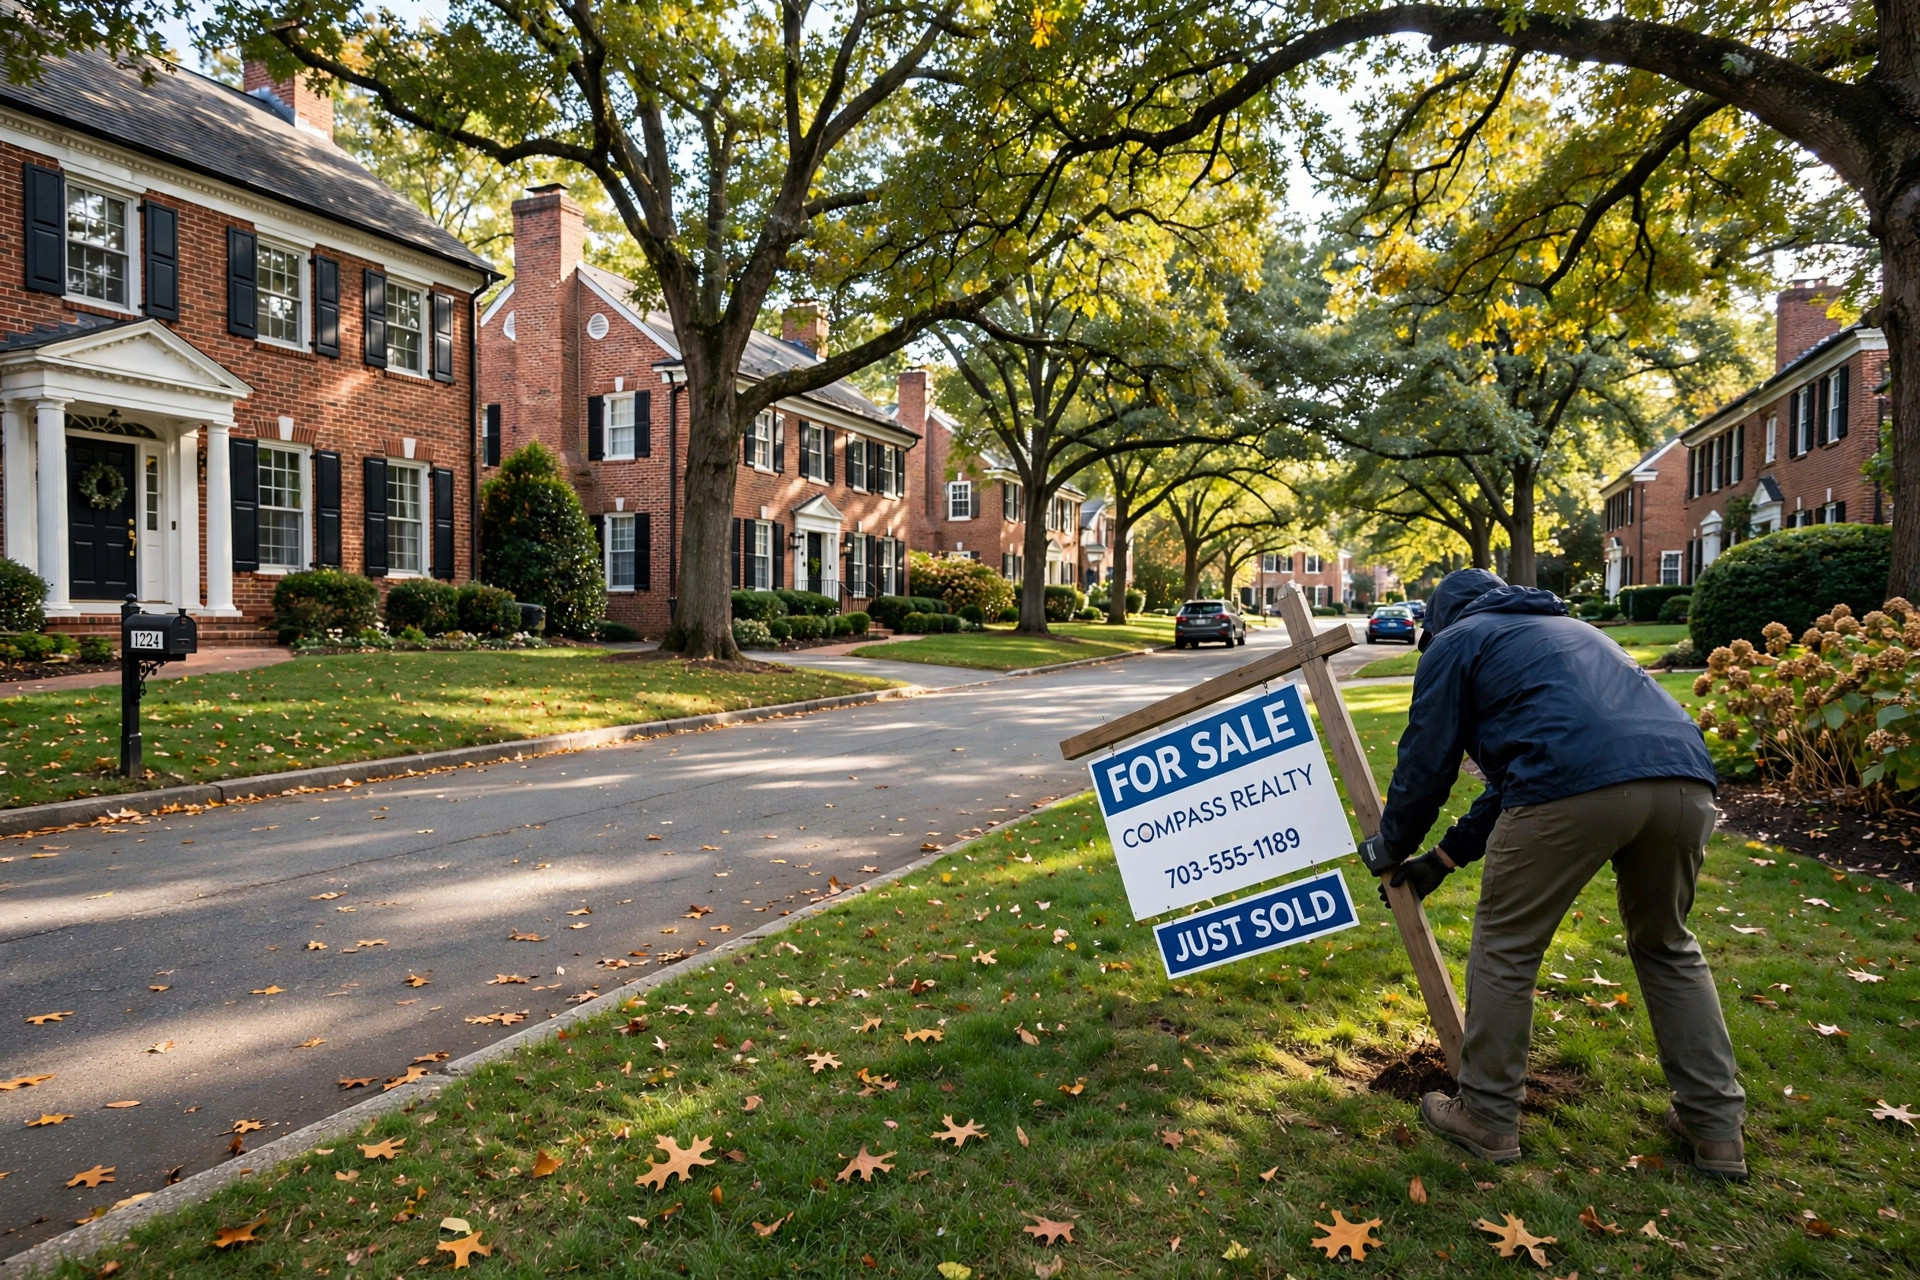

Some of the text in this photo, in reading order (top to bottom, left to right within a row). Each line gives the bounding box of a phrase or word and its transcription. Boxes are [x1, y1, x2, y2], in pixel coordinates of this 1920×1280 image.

[134, 632, 160, 648] 1224
[1106, 699, 1296, 803] FOR SALE
[1122, 763, 1313, 848] COMPASS REALTY
[1164, 827, 1301, 889] 703-555-1189
[1176, 890, 1336, 962] JUST SOLD
